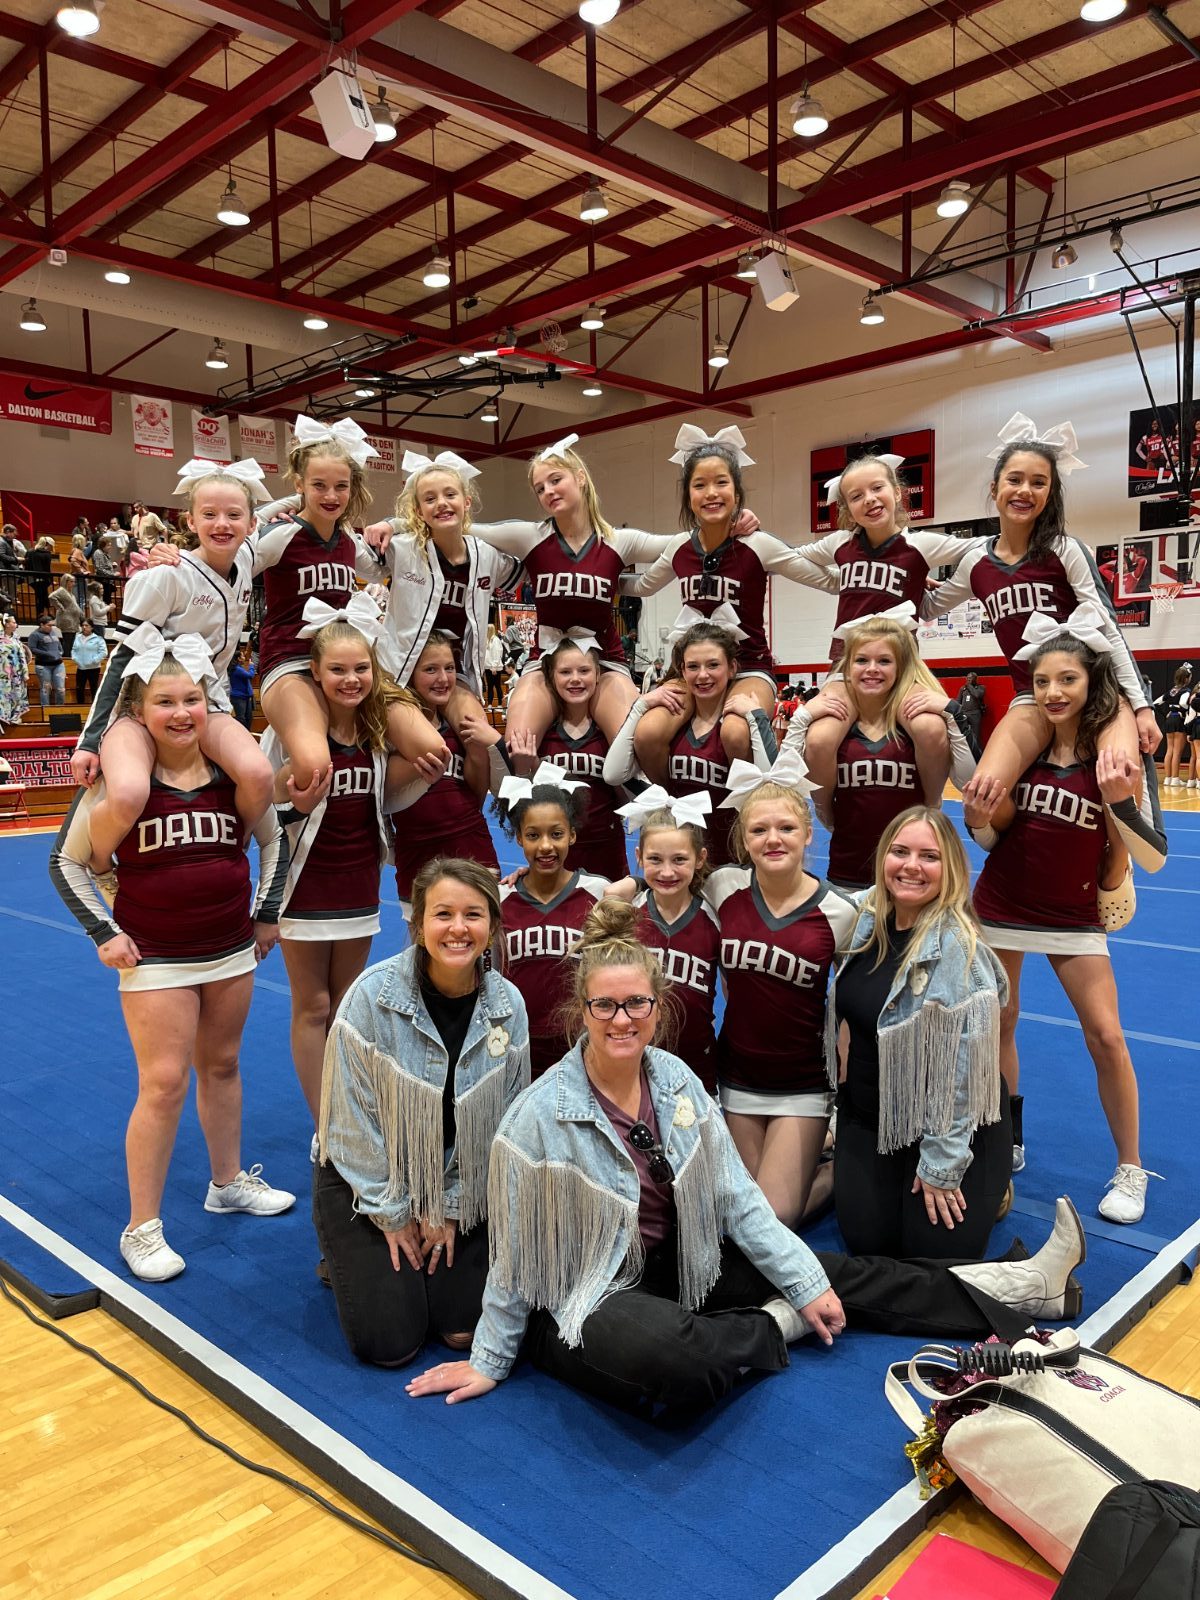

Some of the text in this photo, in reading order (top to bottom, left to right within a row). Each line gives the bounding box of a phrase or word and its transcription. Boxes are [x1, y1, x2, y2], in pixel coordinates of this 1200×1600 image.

[8, 403, 42, 418] DALTON
[44, 409, 96, 427] BASKETBALL
[200, 421, 217, 433] DQ
[240, 427, 275, 440] JONAH'S
[379, 440, 394, 449] DEN
[907, 485, 924, 493] FOULS
[816, 522, 831, 530] SCORE
[535, 572, 612, 603] DADE
[838, 560, 907, 597] DADE
[984, 582, 1058, 625] DADE
[2, 749, 69, 761] WELCOME
[8, 760, 72, 778] DALTO
[669, 755, 728, 788] ADE
[837, 759, 916, 790] DADE
[1014, 783, 1102, 831] DADE
[138, 811, 238, 853] DADE
[720, 938, 820, 989] DADE
[1100, 1385, 1126, 1402] COACH
